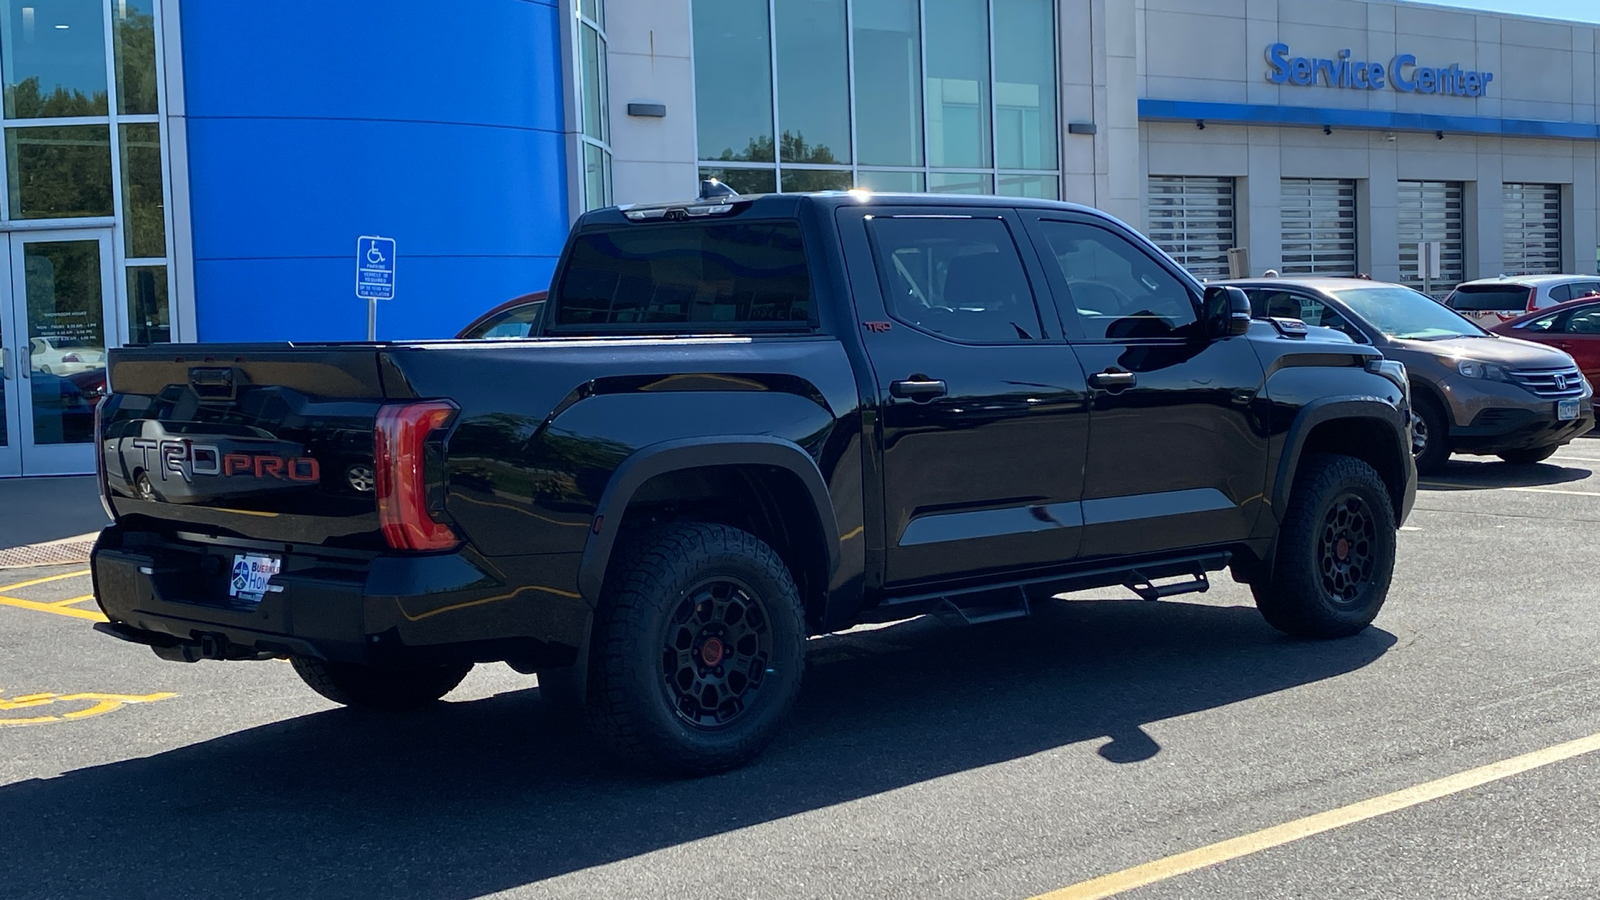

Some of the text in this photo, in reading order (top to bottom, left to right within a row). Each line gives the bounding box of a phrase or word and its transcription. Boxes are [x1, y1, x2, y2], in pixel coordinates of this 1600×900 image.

[1265, 43, 1493, 97] Service Center
[862, 321, 892, 333] TRD
[133, 438, 320, 484] TRD PRO
[249, 572, 268, 590] HON
